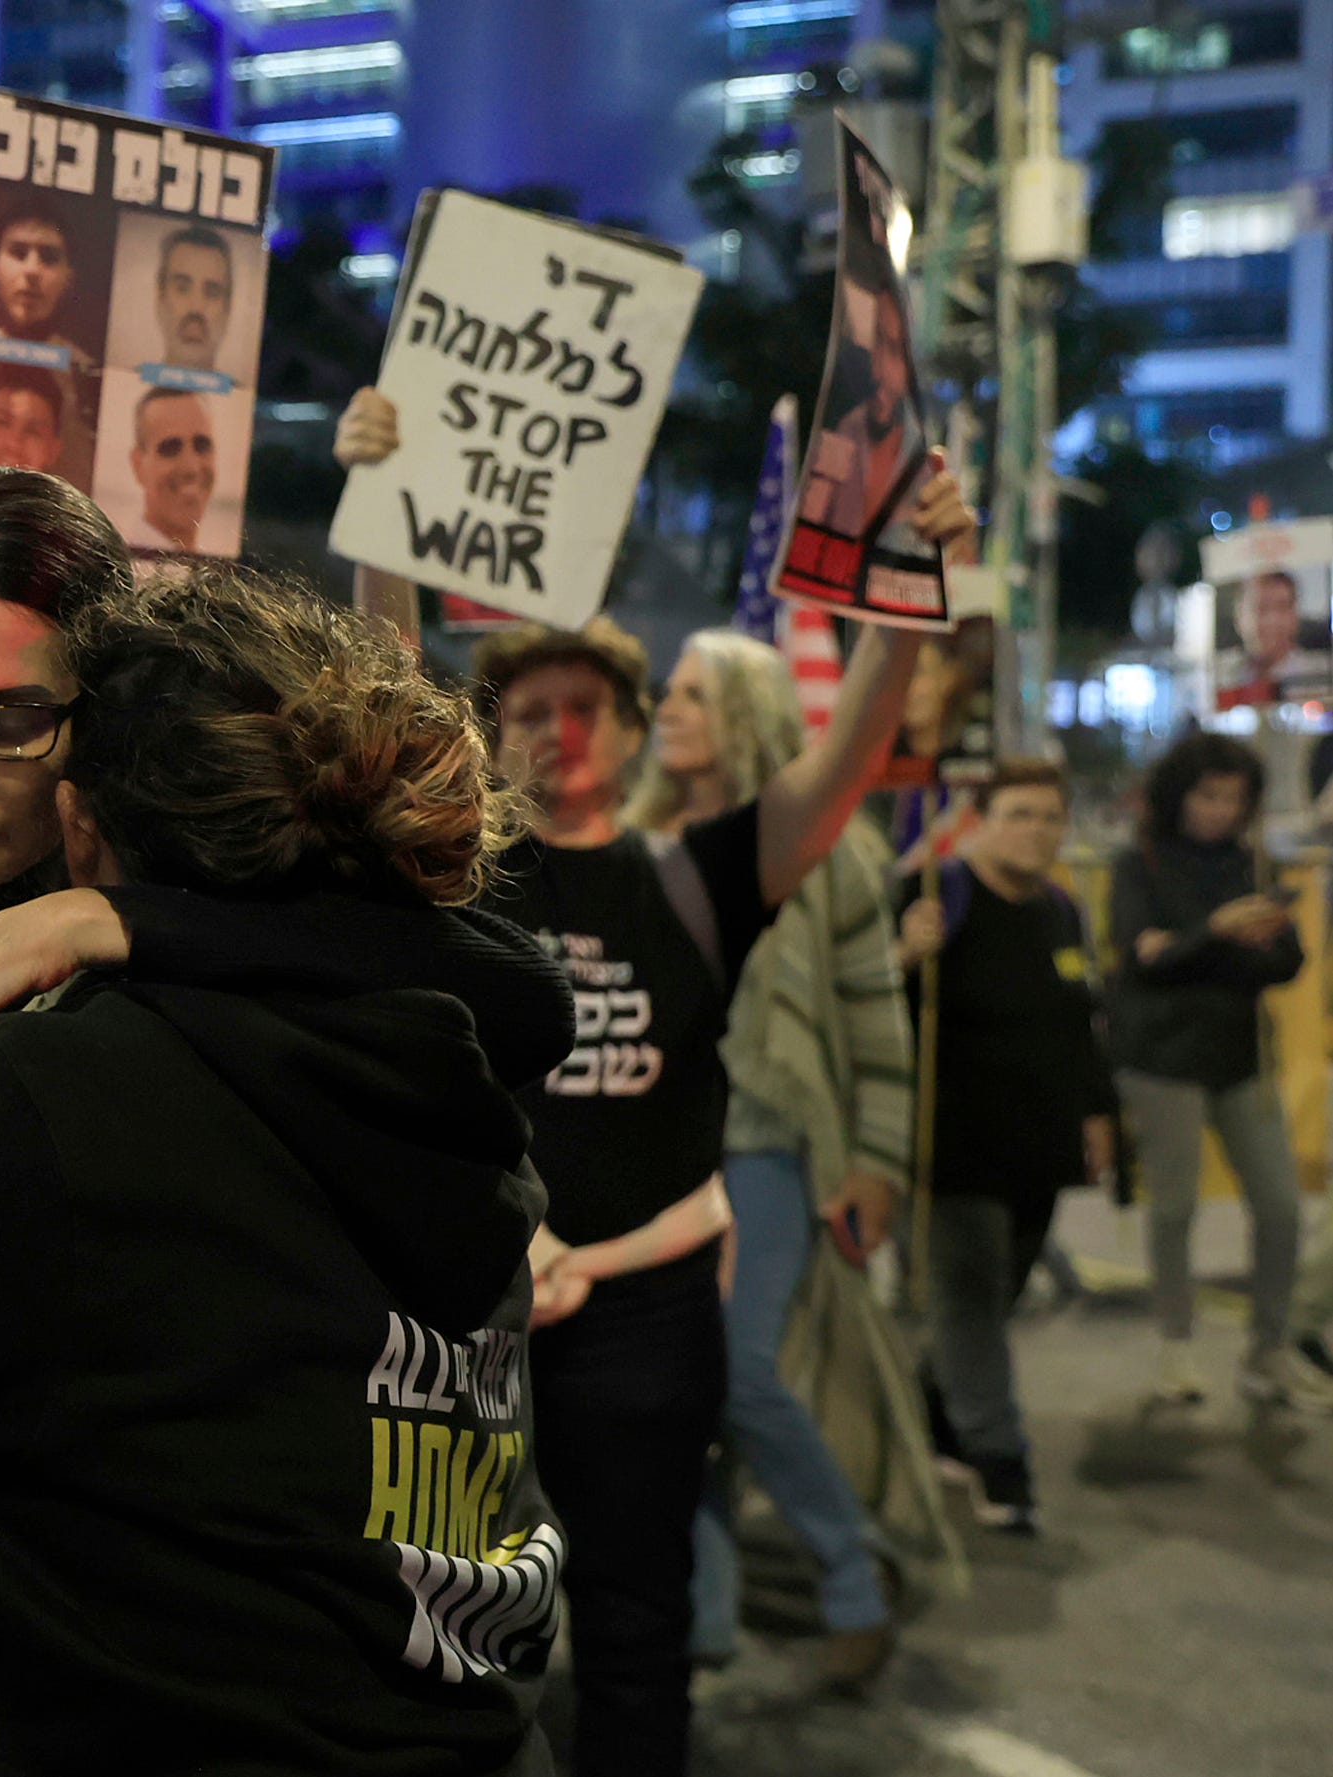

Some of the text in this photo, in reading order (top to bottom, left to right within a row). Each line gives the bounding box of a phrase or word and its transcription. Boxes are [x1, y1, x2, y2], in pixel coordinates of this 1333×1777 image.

[113, 128, 263, 226] כולם
[545, 253, 634, 333] די
[409, 291, 644, 408] למלחמה
[441, 383, 607, 465] STOP
[461, 449, 552, 517] THE
[400, 489, 544, 592] WAR
[366, 1311, 456, 1413] ALL
